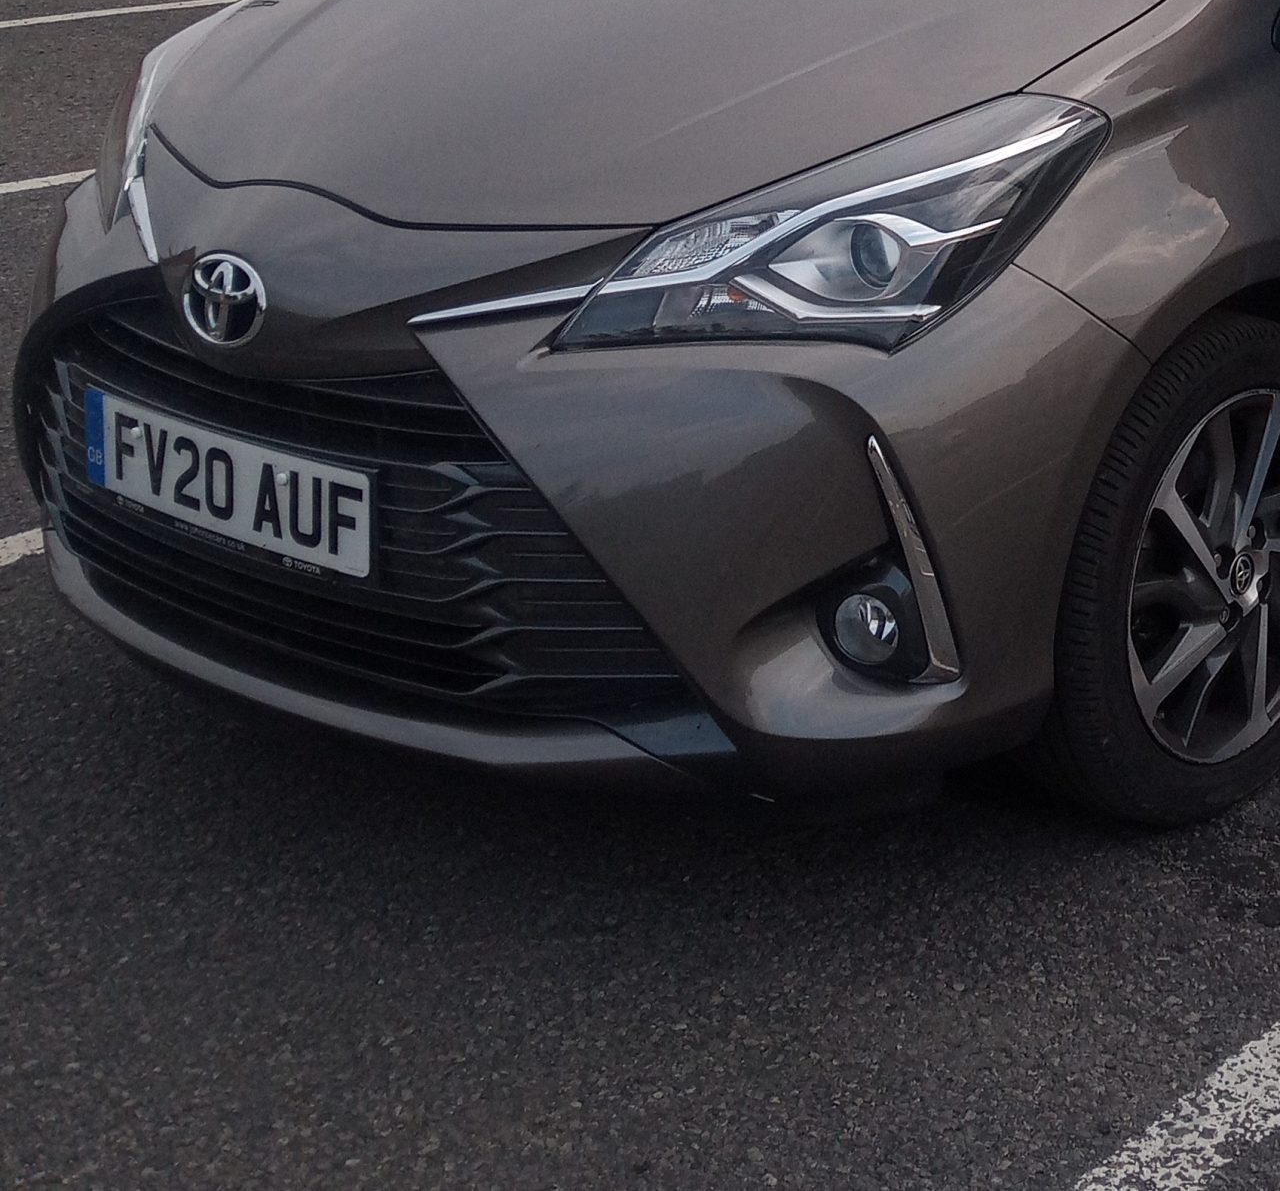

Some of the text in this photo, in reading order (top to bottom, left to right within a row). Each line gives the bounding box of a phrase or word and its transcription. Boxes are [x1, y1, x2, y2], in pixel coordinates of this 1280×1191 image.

[88, 446, 103, 465] GB
[114, 411, 364, 556] FV20 AUF
[293, 560, 321, 575] TOYOTA
